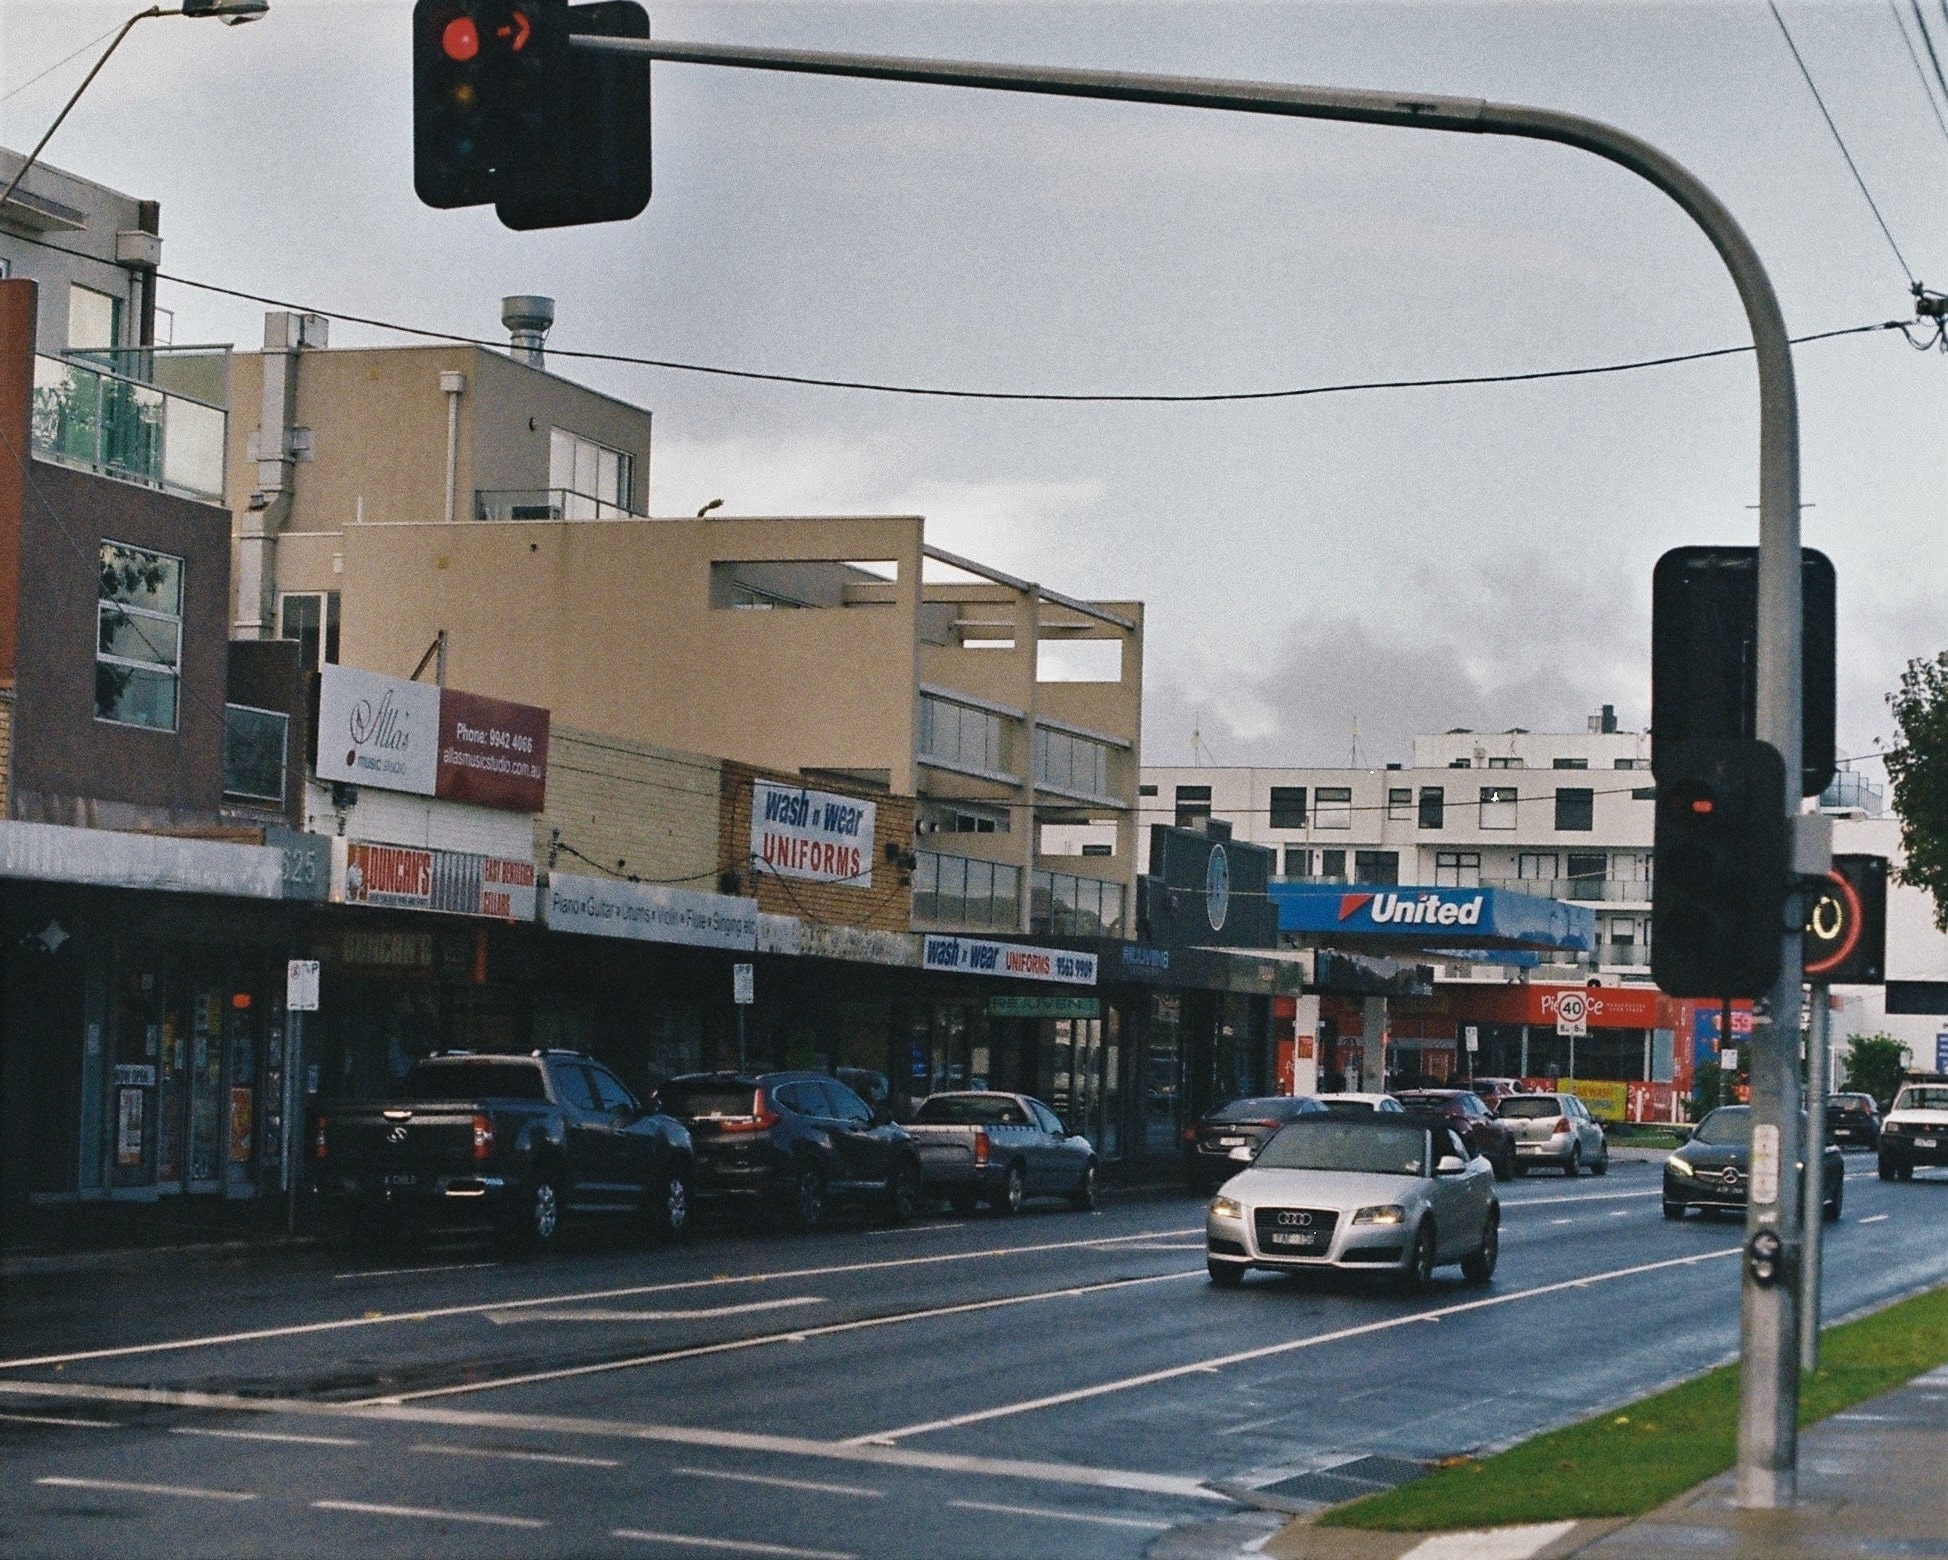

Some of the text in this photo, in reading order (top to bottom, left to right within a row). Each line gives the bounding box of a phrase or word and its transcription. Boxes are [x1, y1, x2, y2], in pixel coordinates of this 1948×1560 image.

[456, 722, 488, 746] Phone:
[765, 788, 864, 837] wash n wear
[368, 845, 431, 896] DUNCAN'S
[763, 832, 860, 878] UNIFORMS
[1371, 892, 1484, 925] United
[927, 937, 960, 967] wash
[970, 944, 999, 970] wear
[1005, 950, 1051, 975] UNIFORMS
[1562, 1001, 1582, 1015] 40
